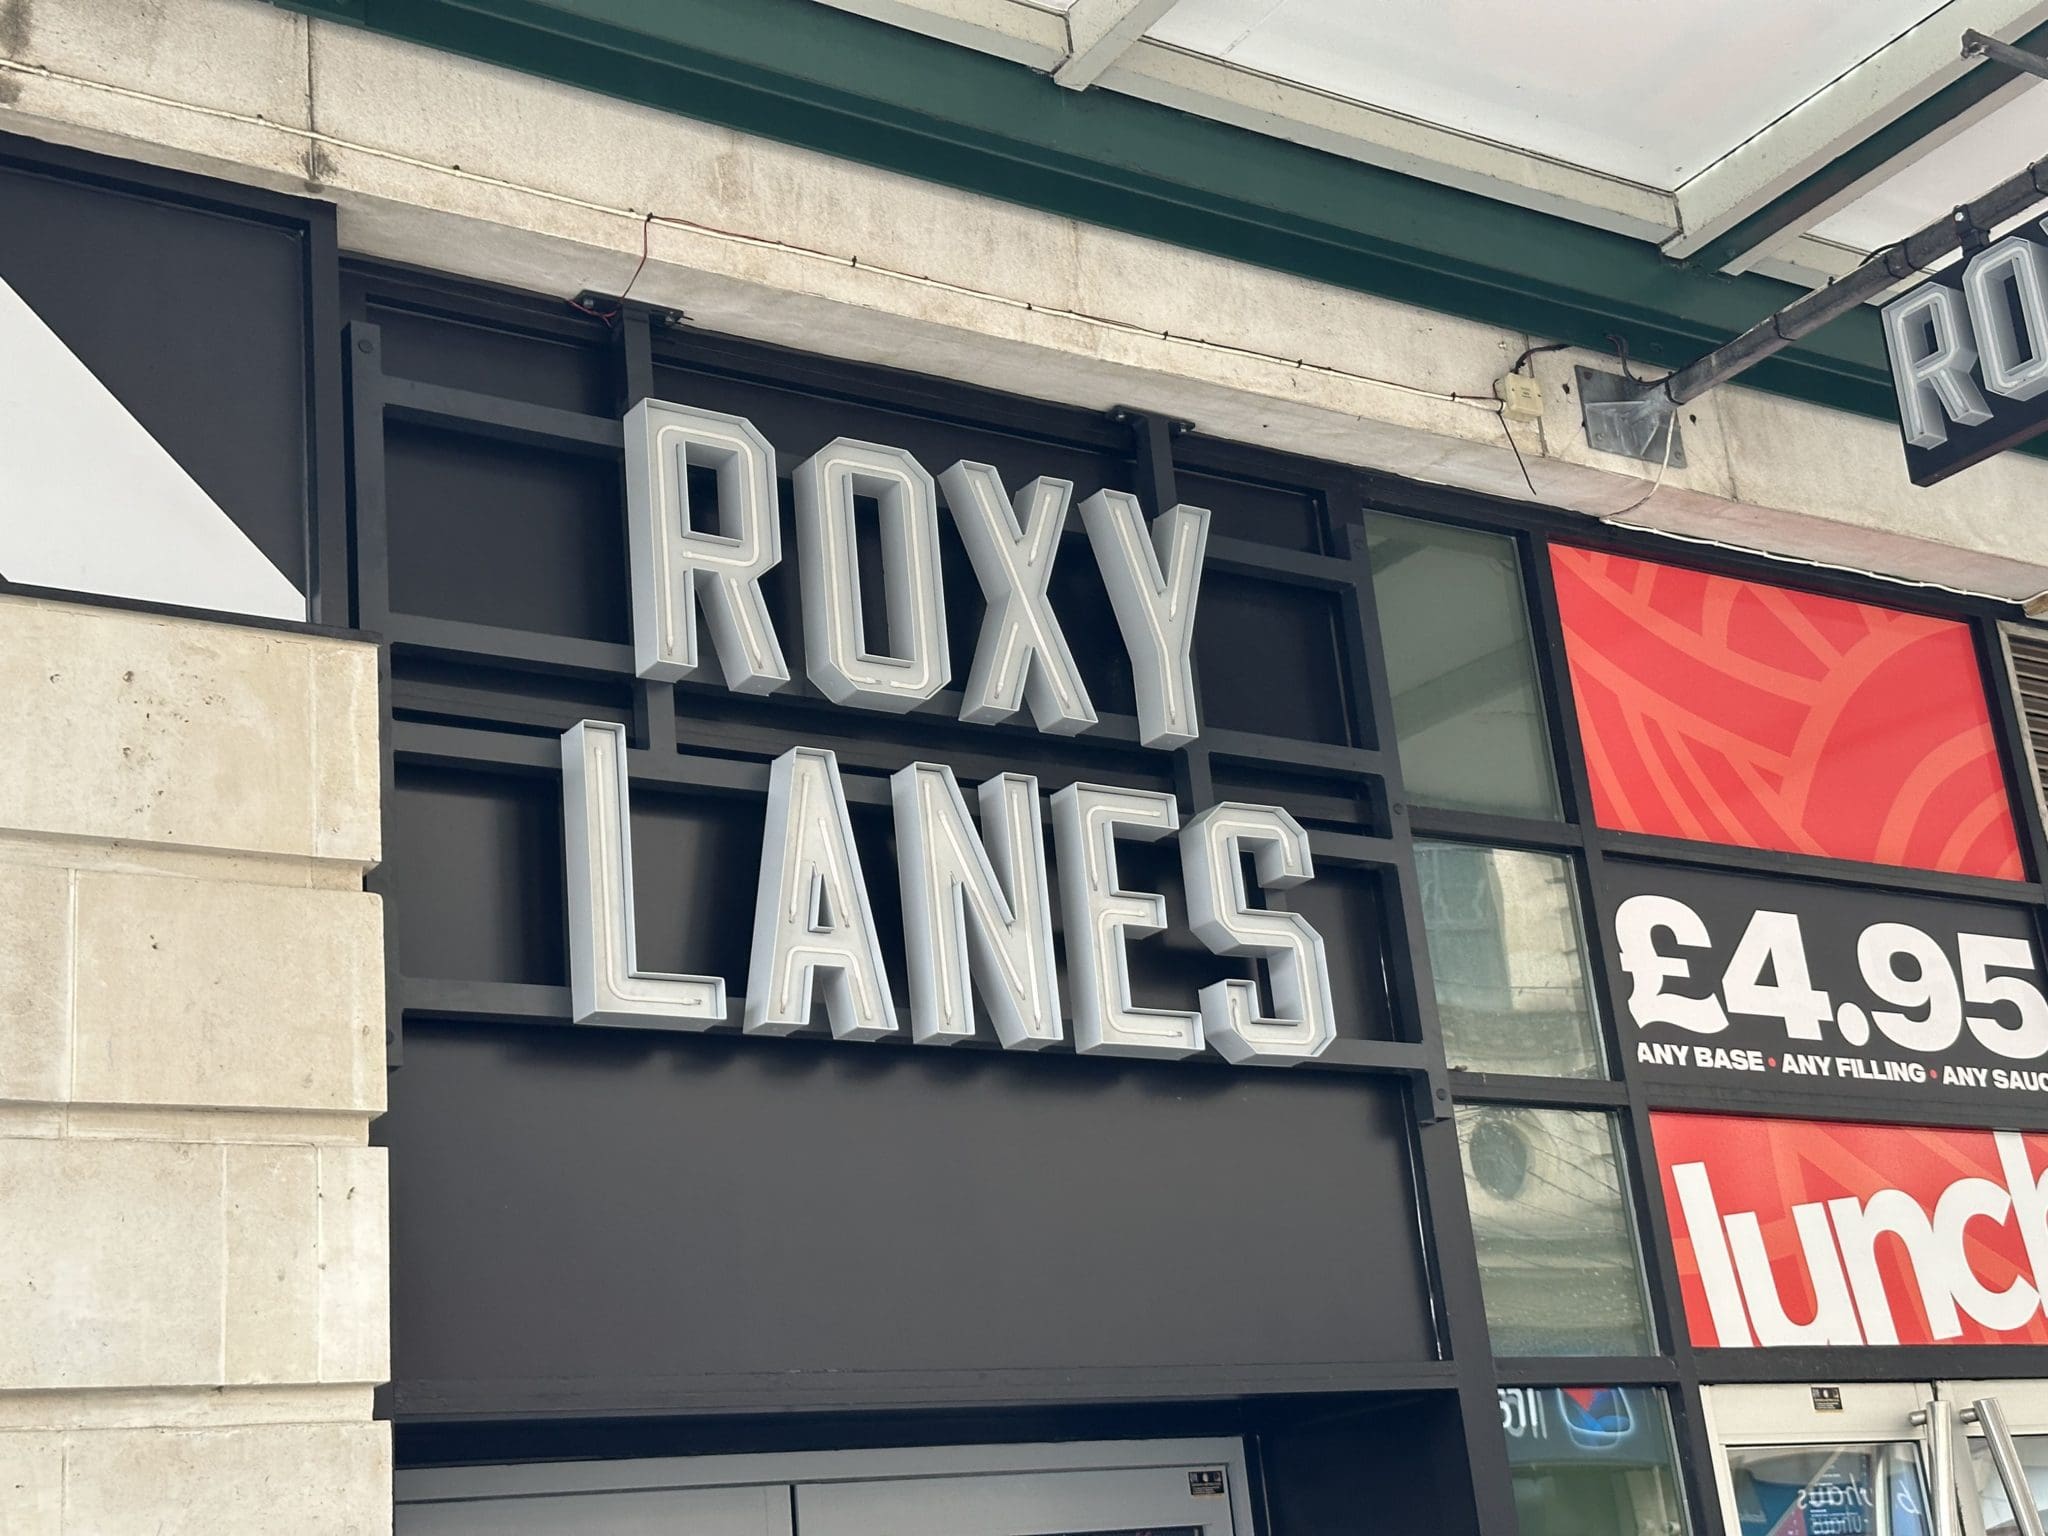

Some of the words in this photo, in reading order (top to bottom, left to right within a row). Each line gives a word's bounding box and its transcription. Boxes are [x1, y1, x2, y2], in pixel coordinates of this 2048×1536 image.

[1881, 216, 2048, 450] RO
[624, 398, 1211, 750] ROXY
[561, 719, 1337, 1066] LANES
[1615, 895, 2048, 1059] £4.95
[1637, 1042, 1690, 1066] ANY
[1694, 1046, 1765, 1072] BASE
[1782, 1054, 1834, 1078] ANY
[1837, 1058, 1926, 1083] FILLING
[1943, 1065, 1988, 1088] ANY
